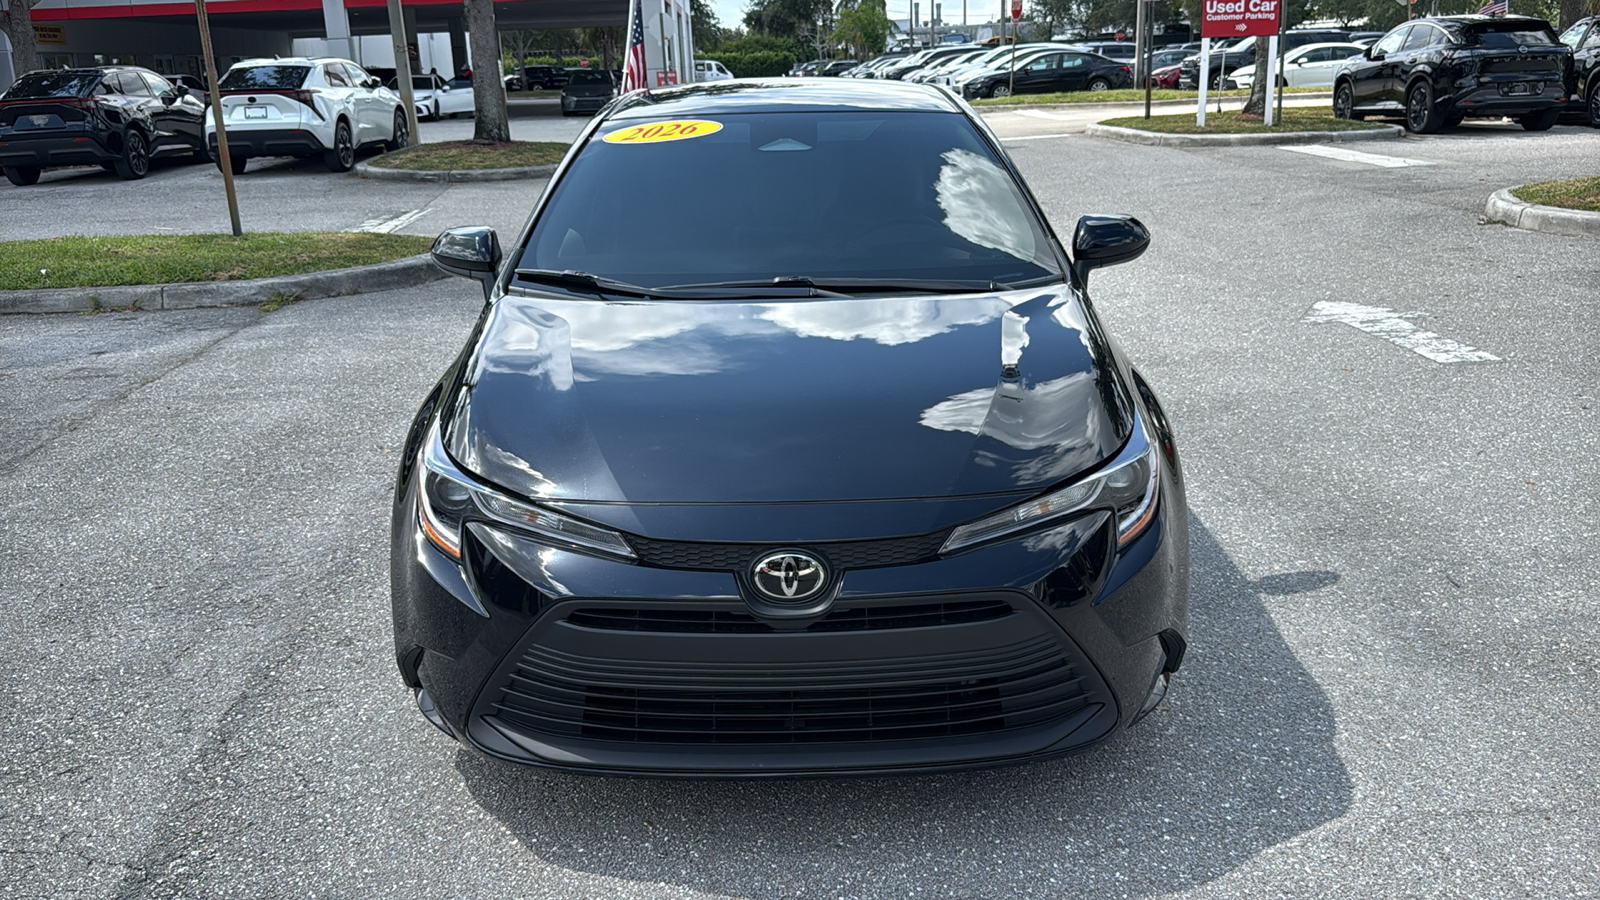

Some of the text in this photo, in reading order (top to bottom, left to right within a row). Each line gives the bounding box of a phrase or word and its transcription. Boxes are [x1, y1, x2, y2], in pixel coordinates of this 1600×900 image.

[1206, 0, 1277, 13] Used Car
[1206, 12, 1276, 21] Customer Parking
[620, 121, 703, 141] 2026
